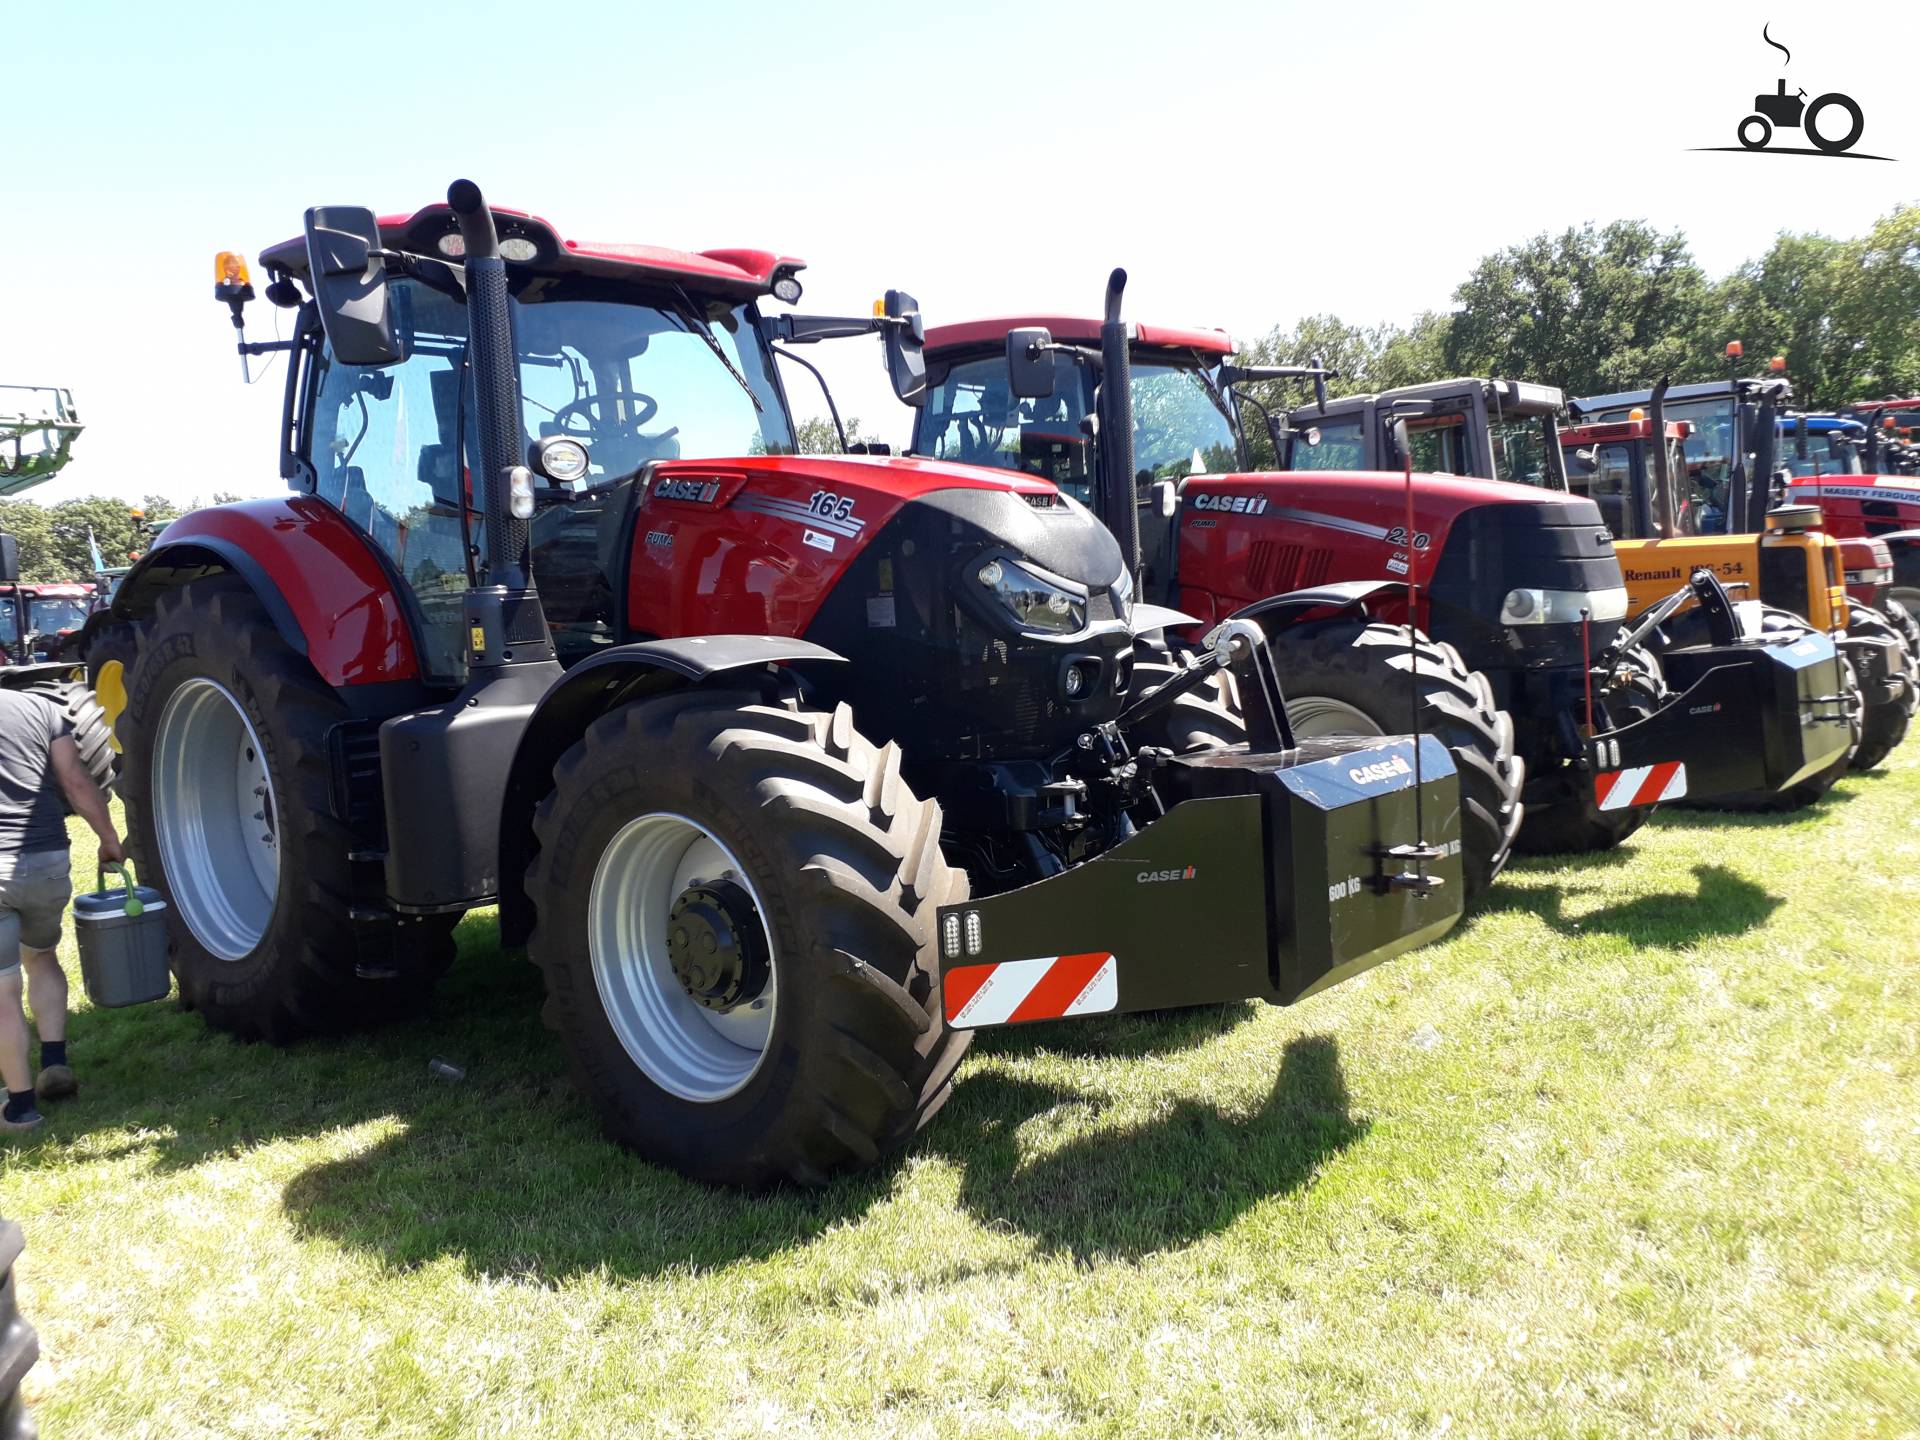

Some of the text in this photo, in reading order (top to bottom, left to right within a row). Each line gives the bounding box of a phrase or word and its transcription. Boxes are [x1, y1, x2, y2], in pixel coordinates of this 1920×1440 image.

[654, 478, 703, 500] CASE
[1823, 487, 1868, 496] MASSEY
[809, 490, 855, 521] 165
[1195, 494, 1248, 513] CASE
[645, 530, 673, 546] PUMA
[1624, 567, 1681, 581] Renault
[1349, 762, 1395, 784] CASE
[1136, 869, 1181, 883] CASE
[1328, 876, 1361, 902] 600 KG
